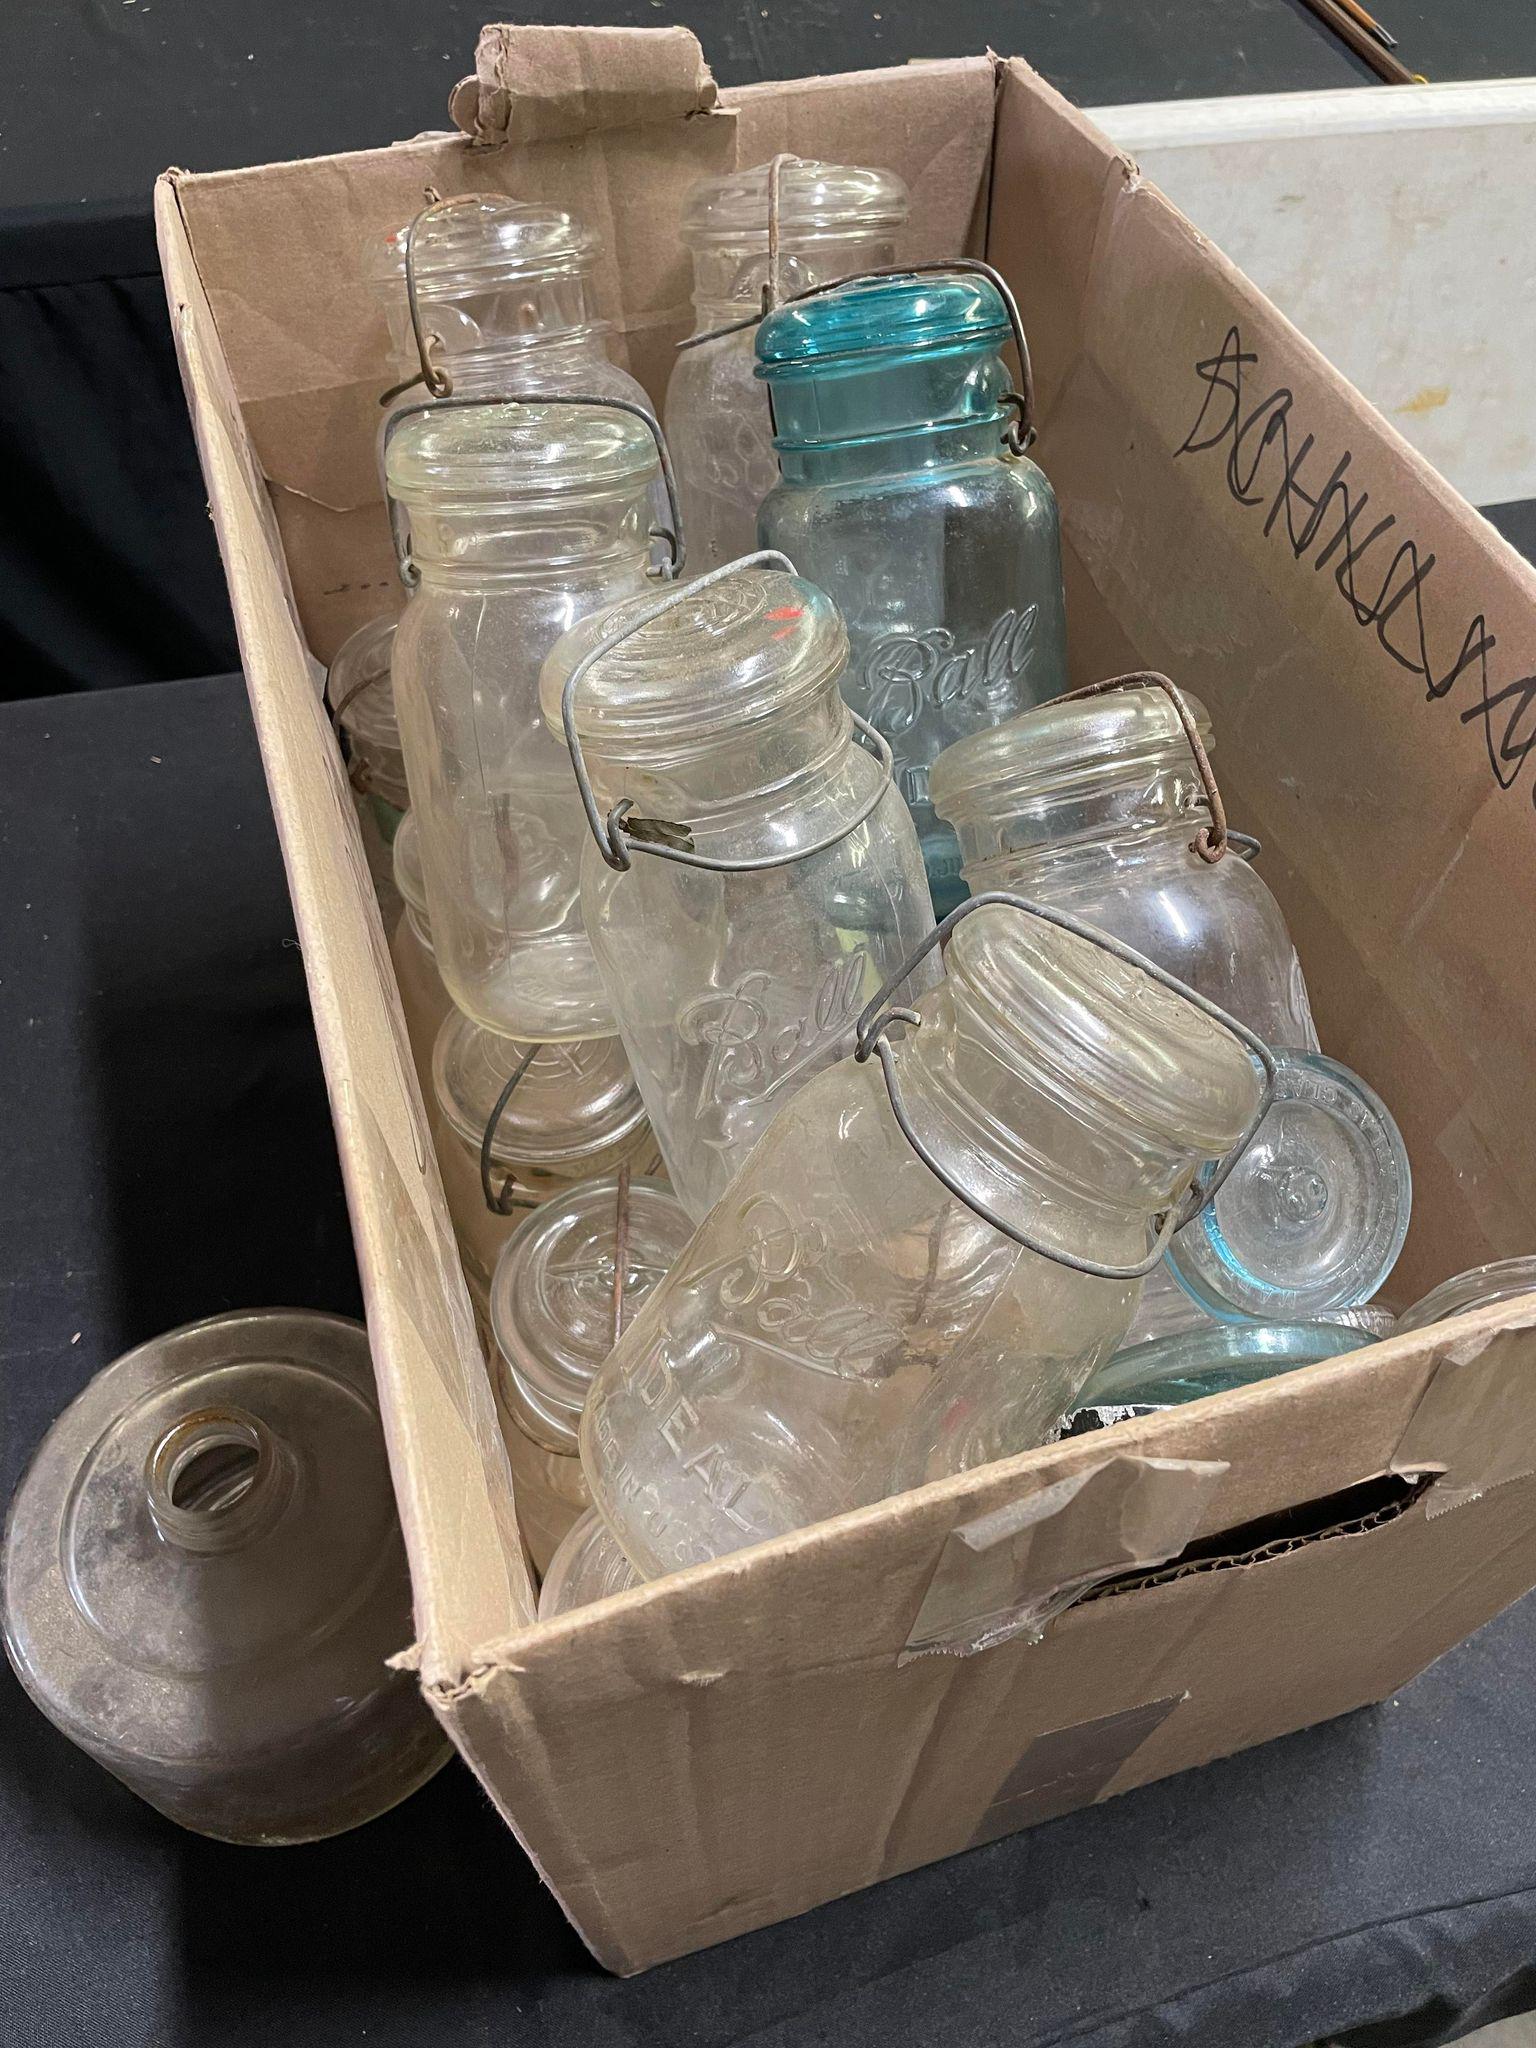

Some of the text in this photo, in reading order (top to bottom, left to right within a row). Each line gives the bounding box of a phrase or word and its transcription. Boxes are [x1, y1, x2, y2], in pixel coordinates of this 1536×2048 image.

[857, 604, 1038, 742] Ball
[677, 951, 867, 1119] Ball
[677, 1192, 905, 1388] Ball
[620, 1318, 756, 1536] IDEAL
